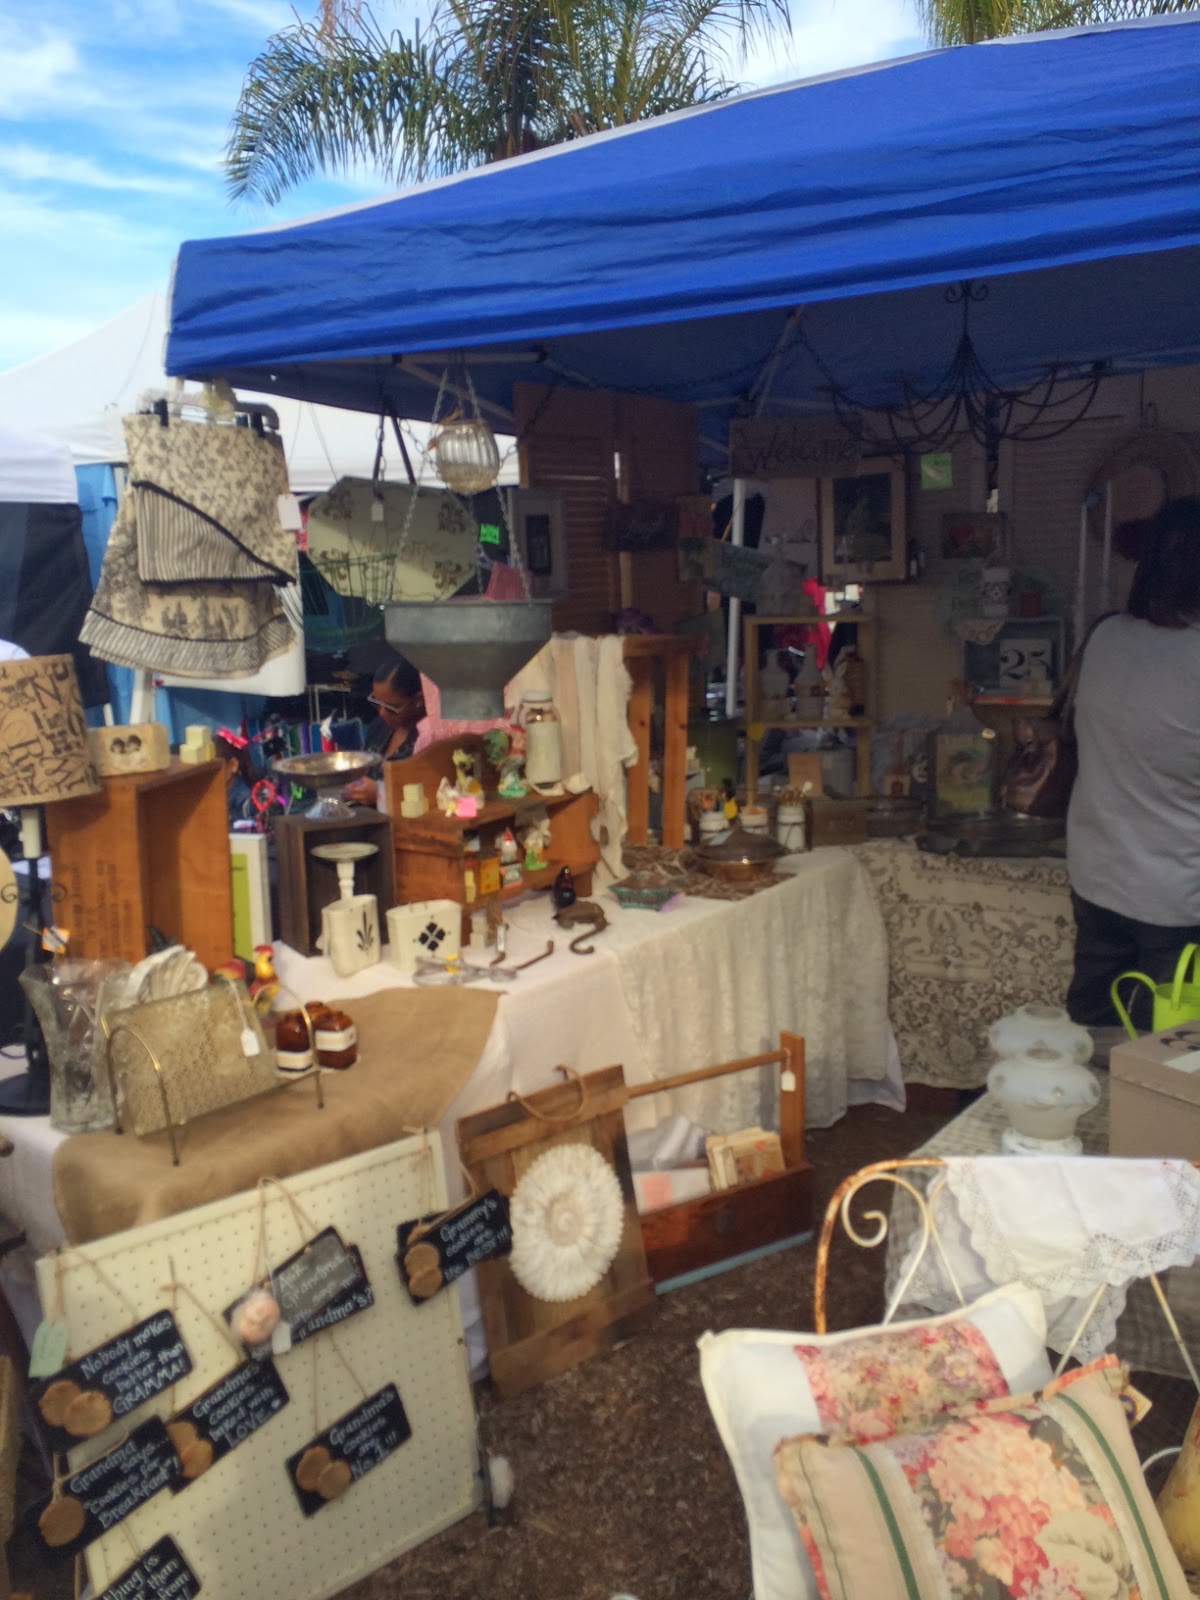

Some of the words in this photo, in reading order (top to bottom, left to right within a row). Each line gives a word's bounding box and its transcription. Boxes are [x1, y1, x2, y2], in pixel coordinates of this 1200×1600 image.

[80, 1339, 132, 1380] Nobody
[132, 1317, 172, 1348] makes
[102, 1350, 151, 1385] cookies
[115, 1361, 156, 1393] better
[157, 1342, 184, 1365] than
[247, 1387, 274, 1409] with
[70, 1440, 137, 1493] Grandma
[146, 1560, 178, 1590] than
